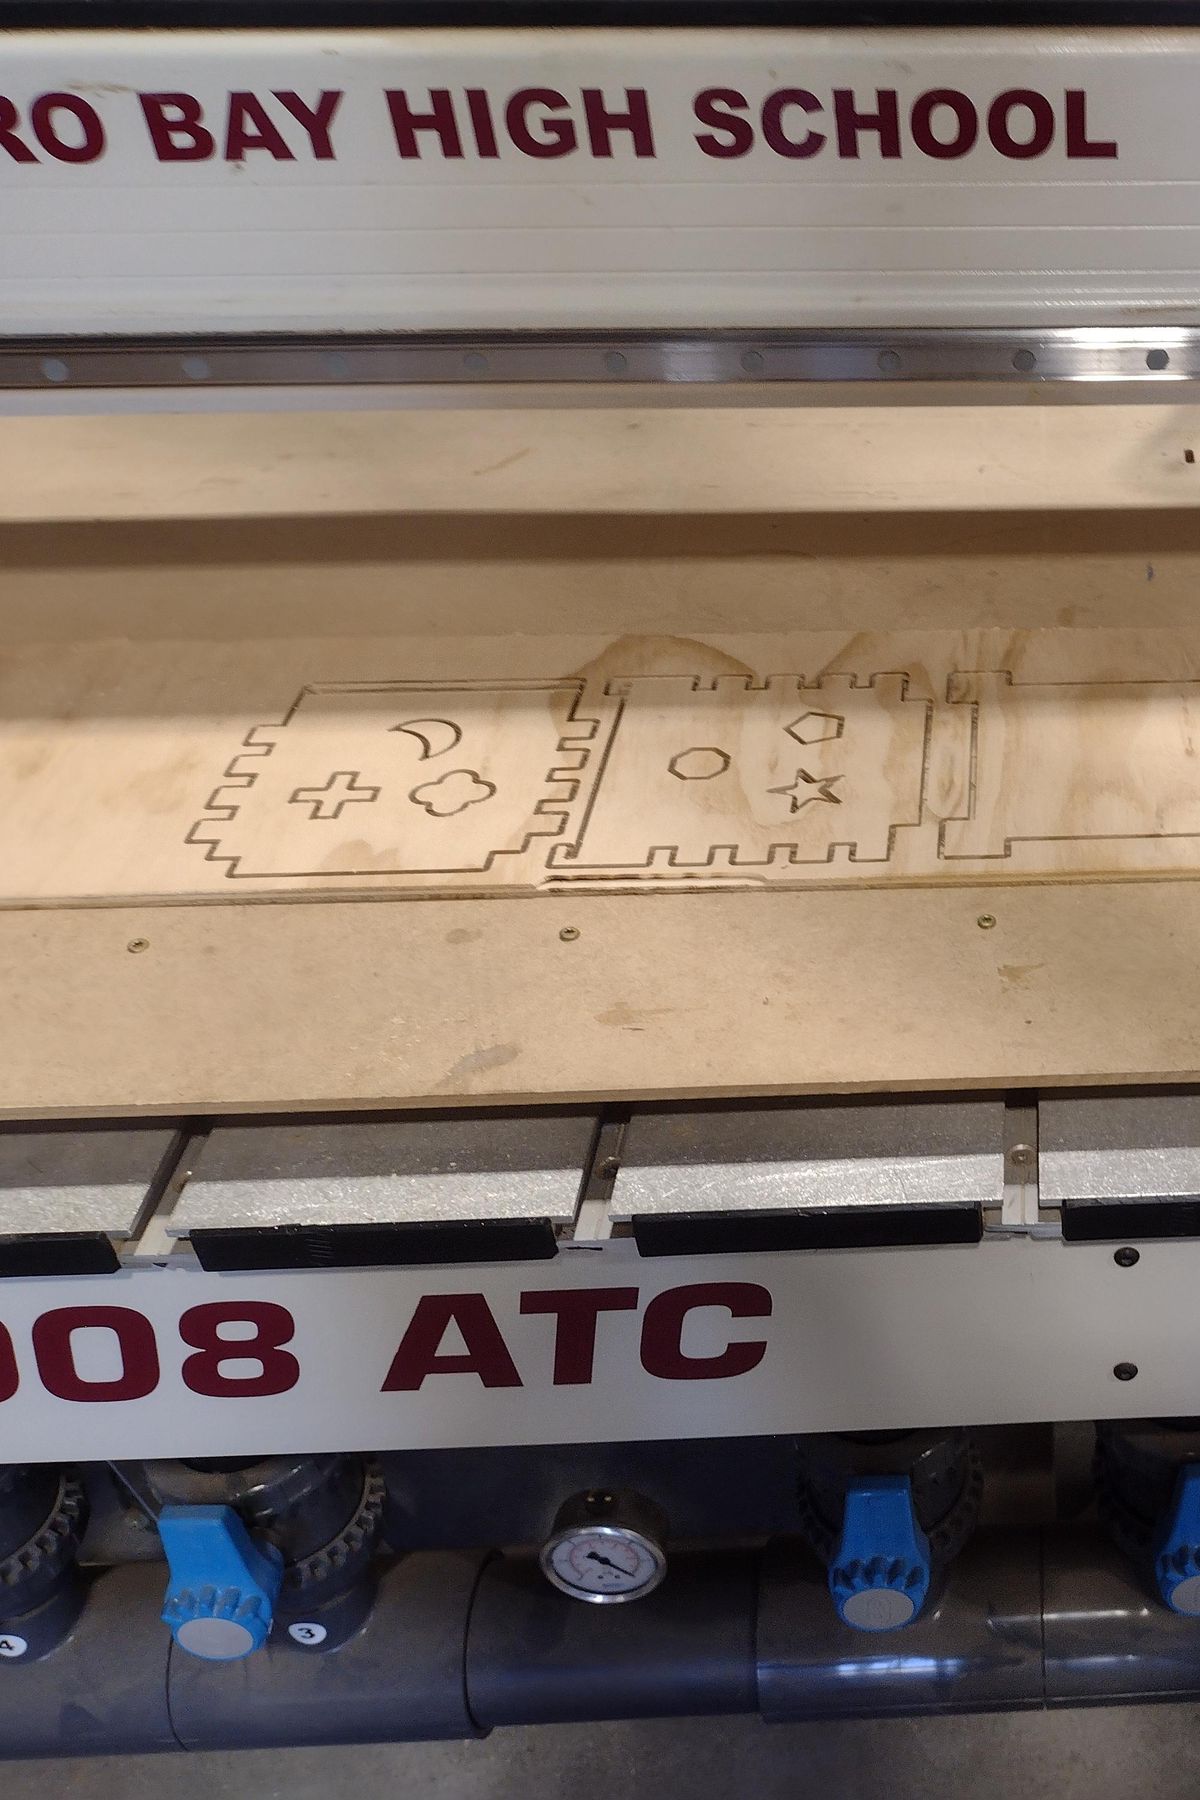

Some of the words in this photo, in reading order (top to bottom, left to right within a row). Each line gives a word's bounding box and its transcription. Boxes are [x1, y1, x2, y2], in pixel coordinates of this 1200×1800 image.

[136, 90, 344, 162] BAY
[384, 88, 657, 160] HIGH
[693, 88, 1119, 160] SCHOOL
[0, 1300, 301, 1403] 08
[380, 1281, 773, 1393] ATC
[297, 1627, 316, 1640] 3
